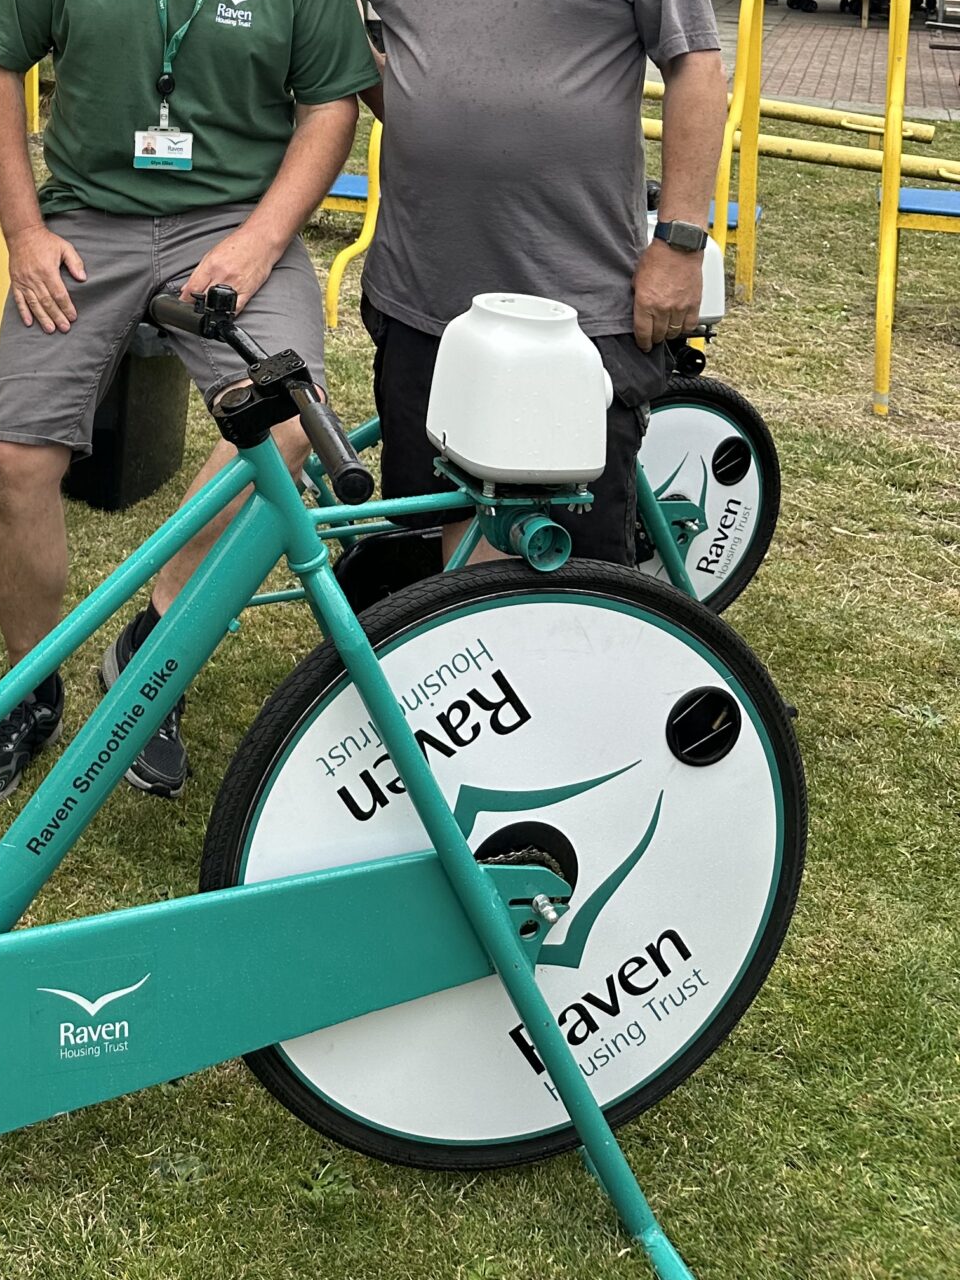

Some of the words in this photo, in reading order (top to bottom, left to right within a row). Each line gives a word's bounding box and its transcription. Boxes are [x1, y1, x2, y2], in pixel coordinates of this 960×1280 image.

[217, 3, 252, 21] Raven
[695, 498, 742, 575] Raven
[716, 536, 743, 580] Housing
[737, 506, 752, 534] Trust
[397, 638, 494, 717] Housin
[26, 796, 79, 856] Raven
[72, 703, 145, 794] Smoothie
[140, 658, 179, 702] Bike
[316, 720, 385, 777] Trust
[59, 1020, 129, 1046] Raven
[60, 1045, 101, 1059] Housing
[103, 1040, 129, 1053] Trust
[543, 1020, 647, 1102] using
[642, 968, 710, 1022] Trust
